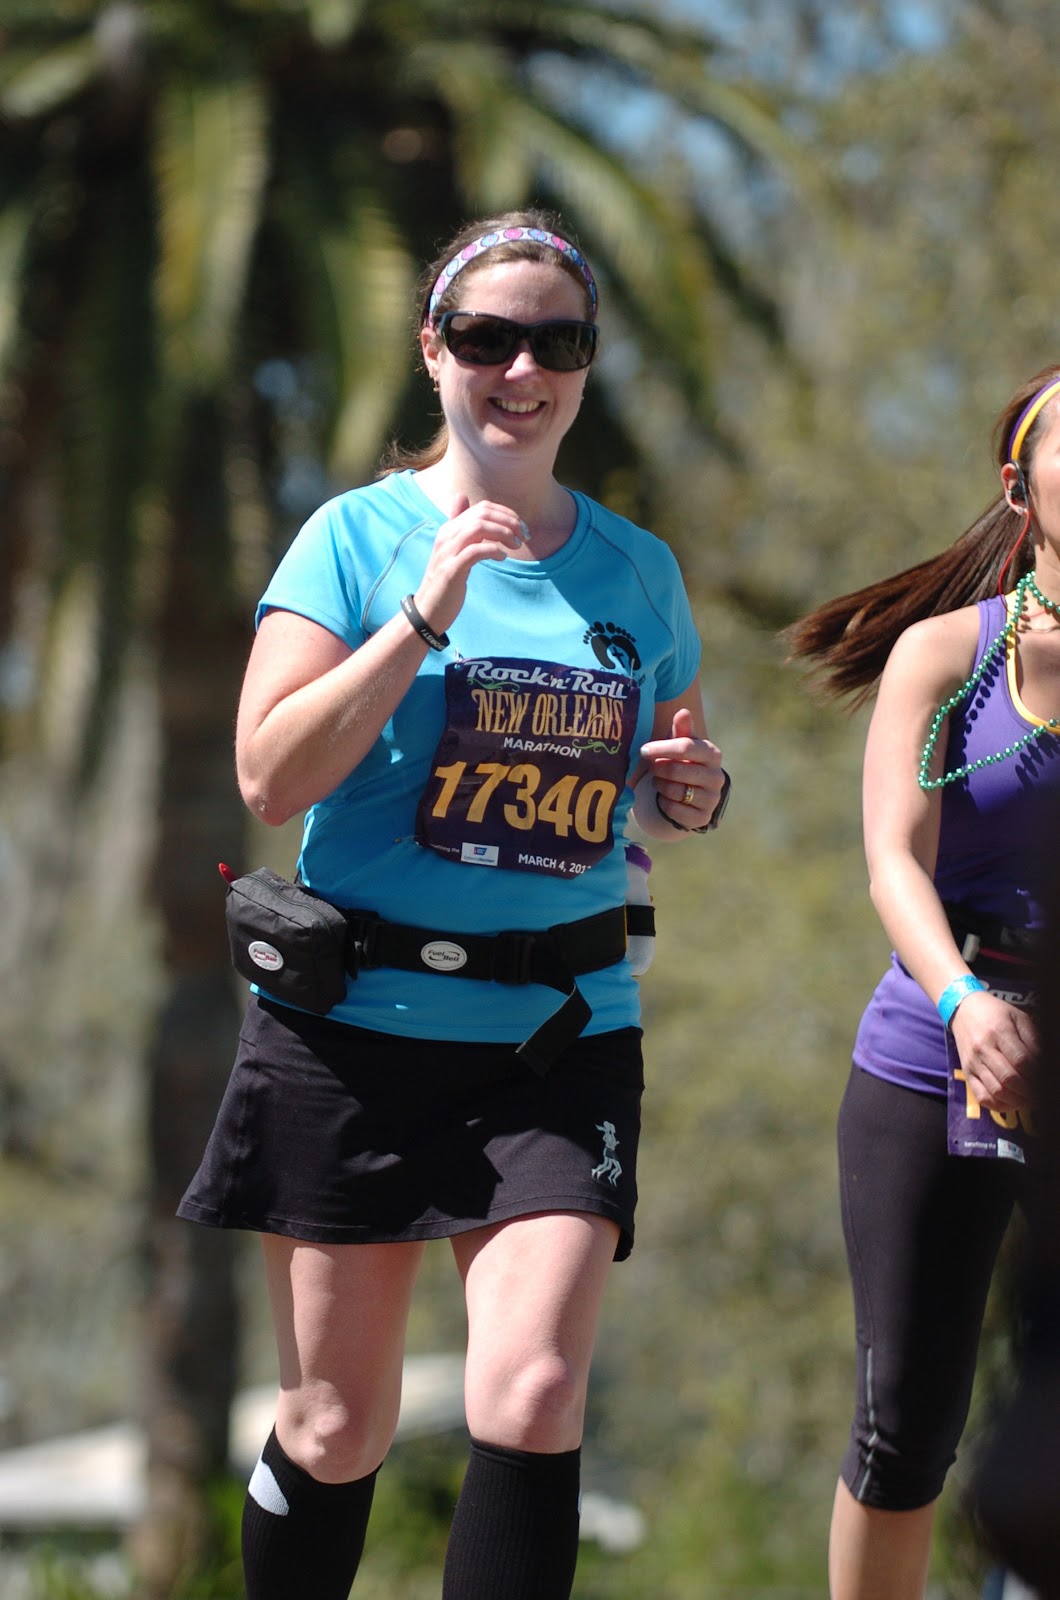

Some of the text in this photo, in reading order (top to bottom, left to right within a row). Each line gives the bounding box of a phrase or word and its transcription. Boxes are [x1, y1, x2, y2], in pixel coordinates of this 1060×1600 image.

[464, 660, 550, 686] Rock
[570, 670, 628, 699] Roll
[471, 688, 624, 741] NEW ORLEANS
[503, 736, 582, 759] MARATHON
[431, 760, 617, 844] 17340
[517, 853, 592, 875] MARCH 4, 201
[428, 949, 446, 957] Fuel
[978, 978, 1041, 1007] ock
